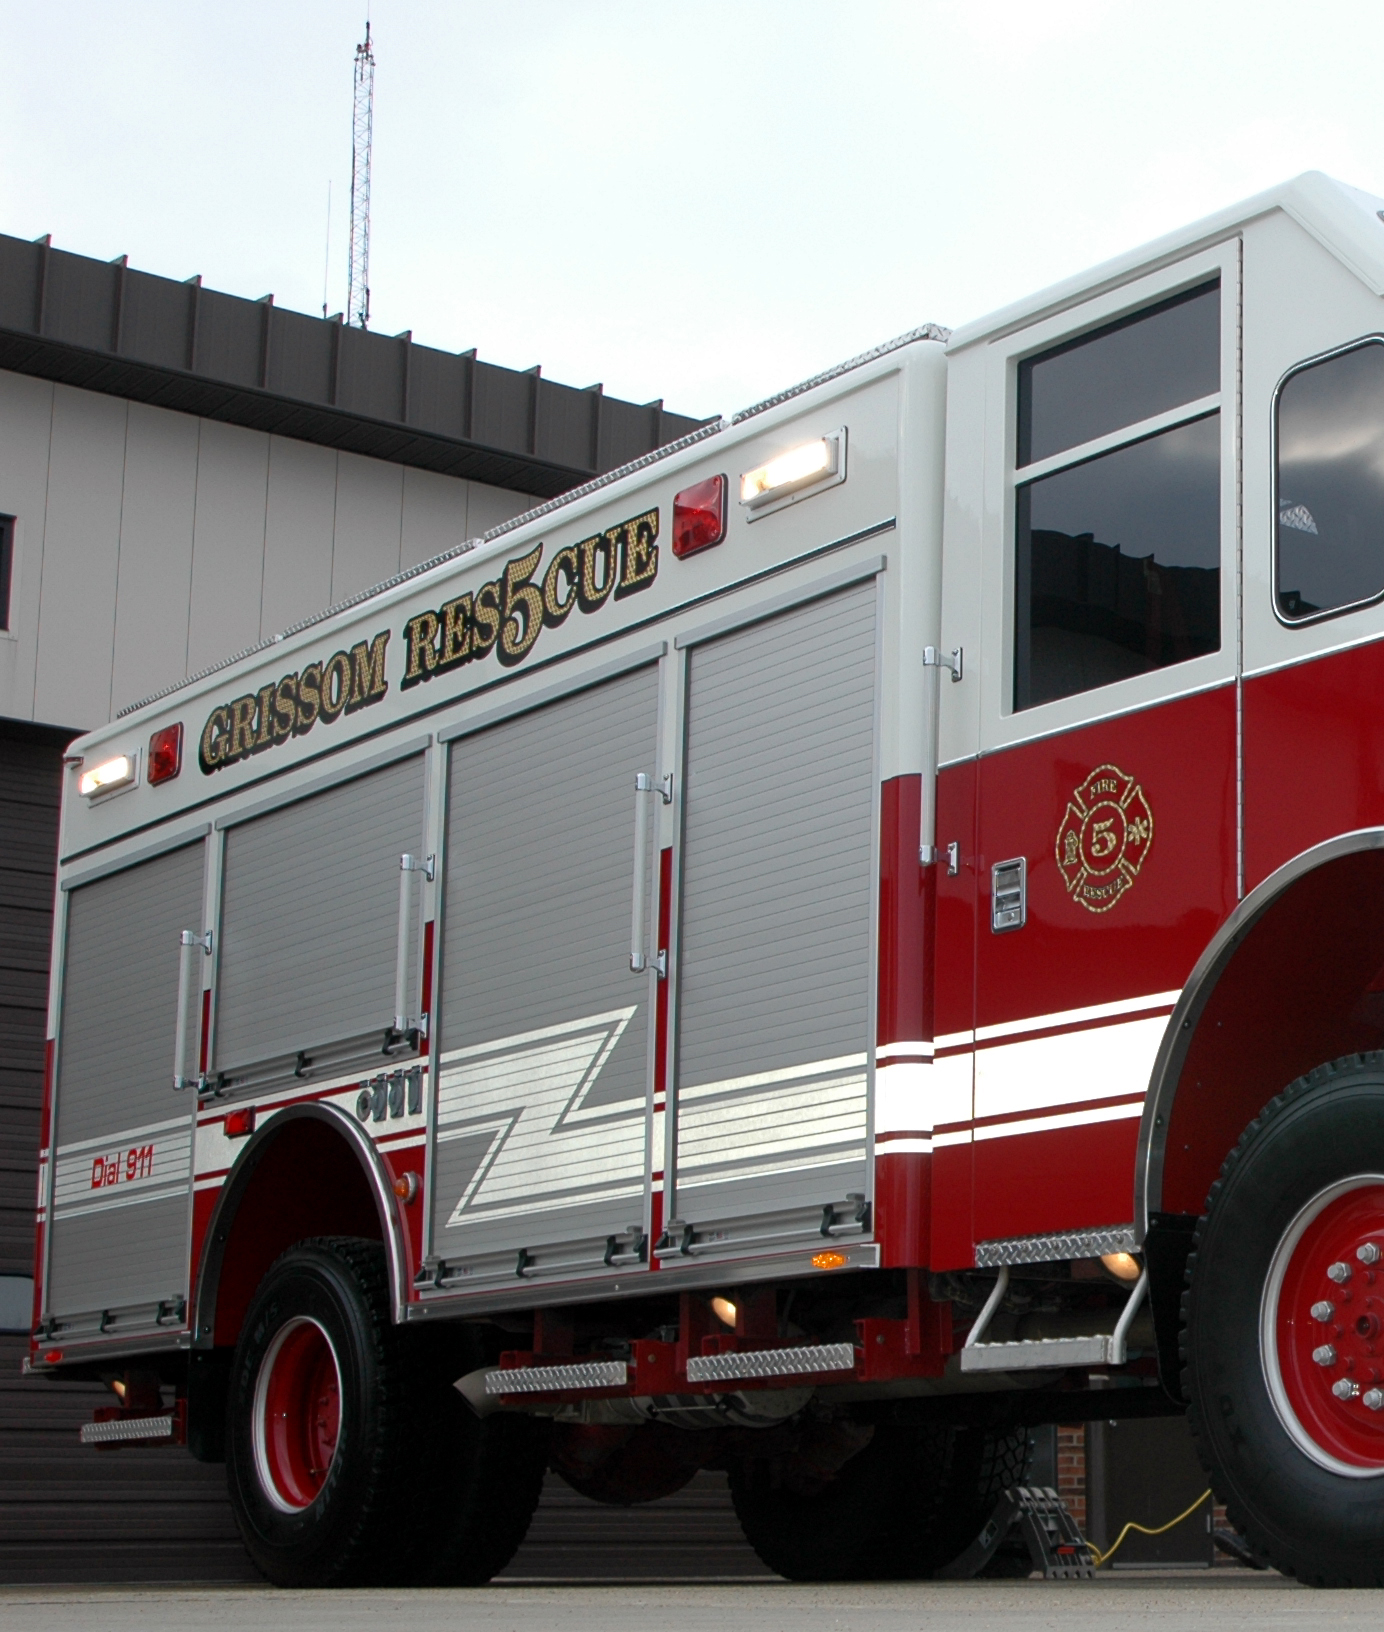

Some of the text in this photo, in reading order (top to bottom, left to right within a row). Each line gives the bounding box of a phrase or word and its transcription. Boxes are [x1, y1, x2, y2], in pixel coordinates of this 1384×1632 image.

[198, 630, 391, 775] GRISSOM
[1090, 778, 1117, 800] FIRE
[1090, 818, 1117, 857] 5
[1083, 875, 1123, 900] RESCUE
[91, 1144, 154, 1189] Dial 911
